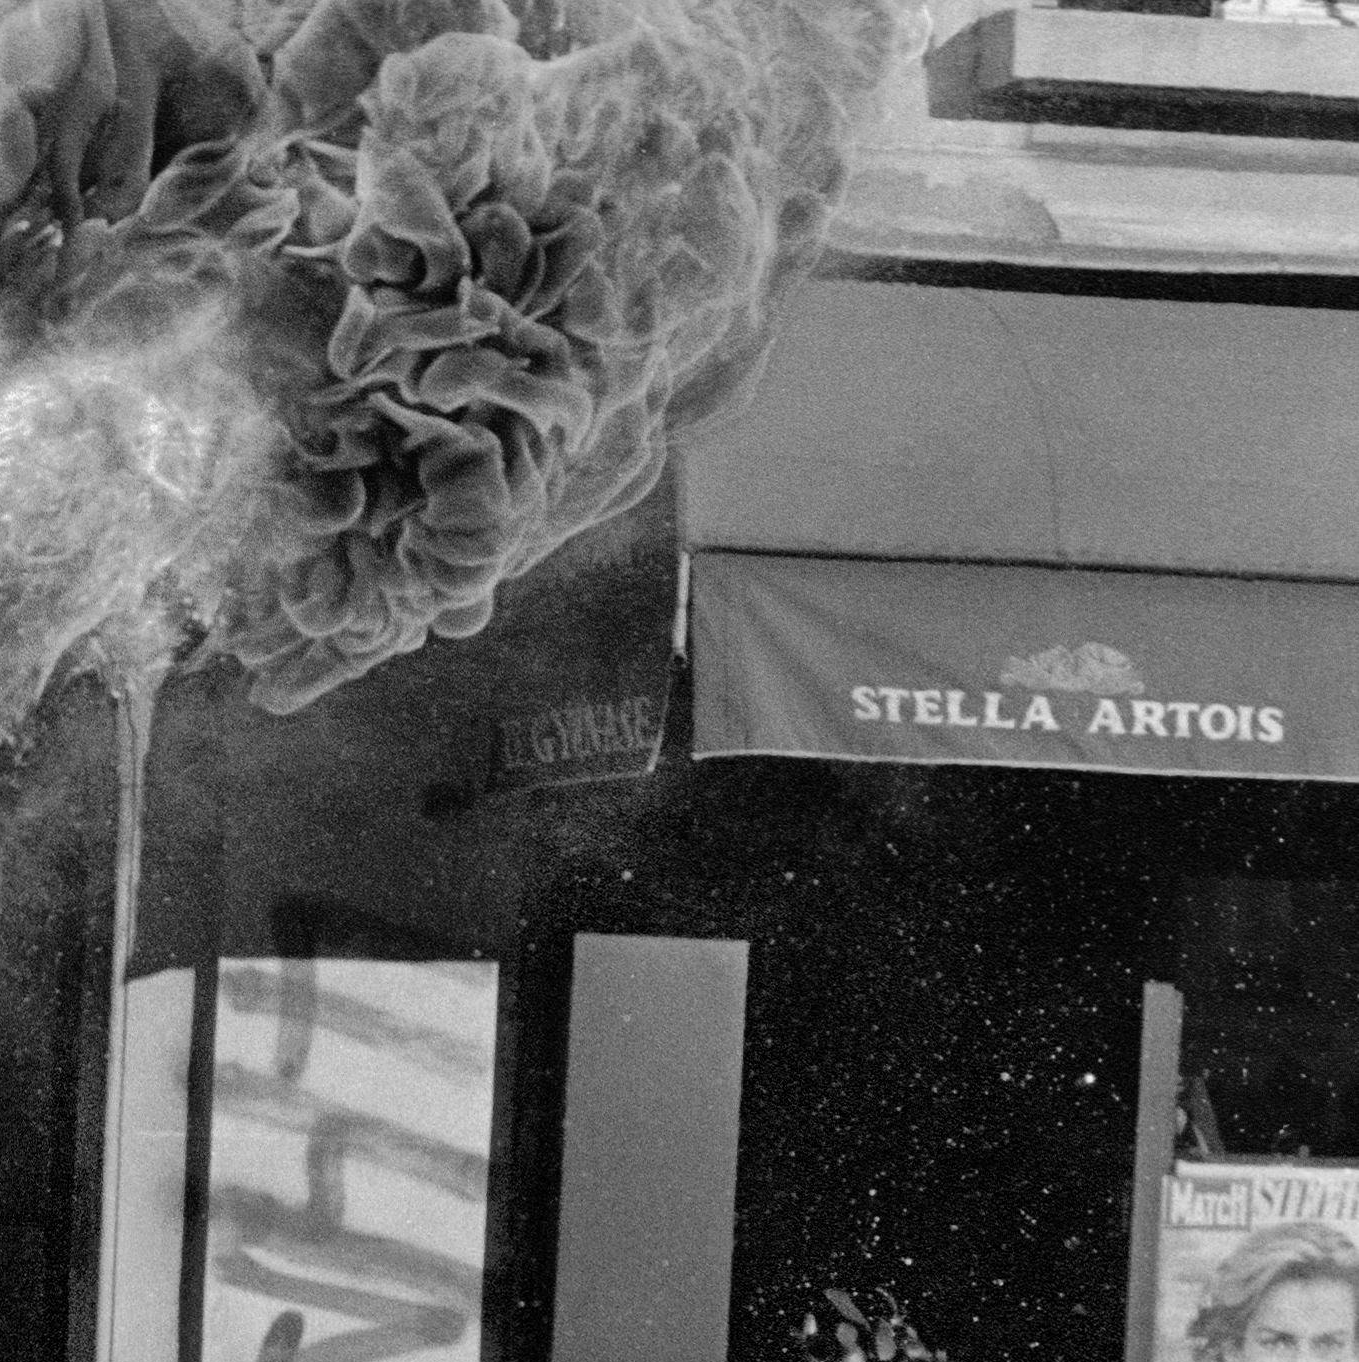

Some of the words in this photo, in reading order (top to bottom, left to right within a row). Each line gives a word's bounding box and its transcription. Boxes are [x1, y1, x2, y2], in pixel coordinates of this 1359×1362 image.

[850, 685, 1061, 732] STELLA
[1087, 697, 1286, 744] ARTOIS
[1170, 1180, 1249, 1226] MATCH
